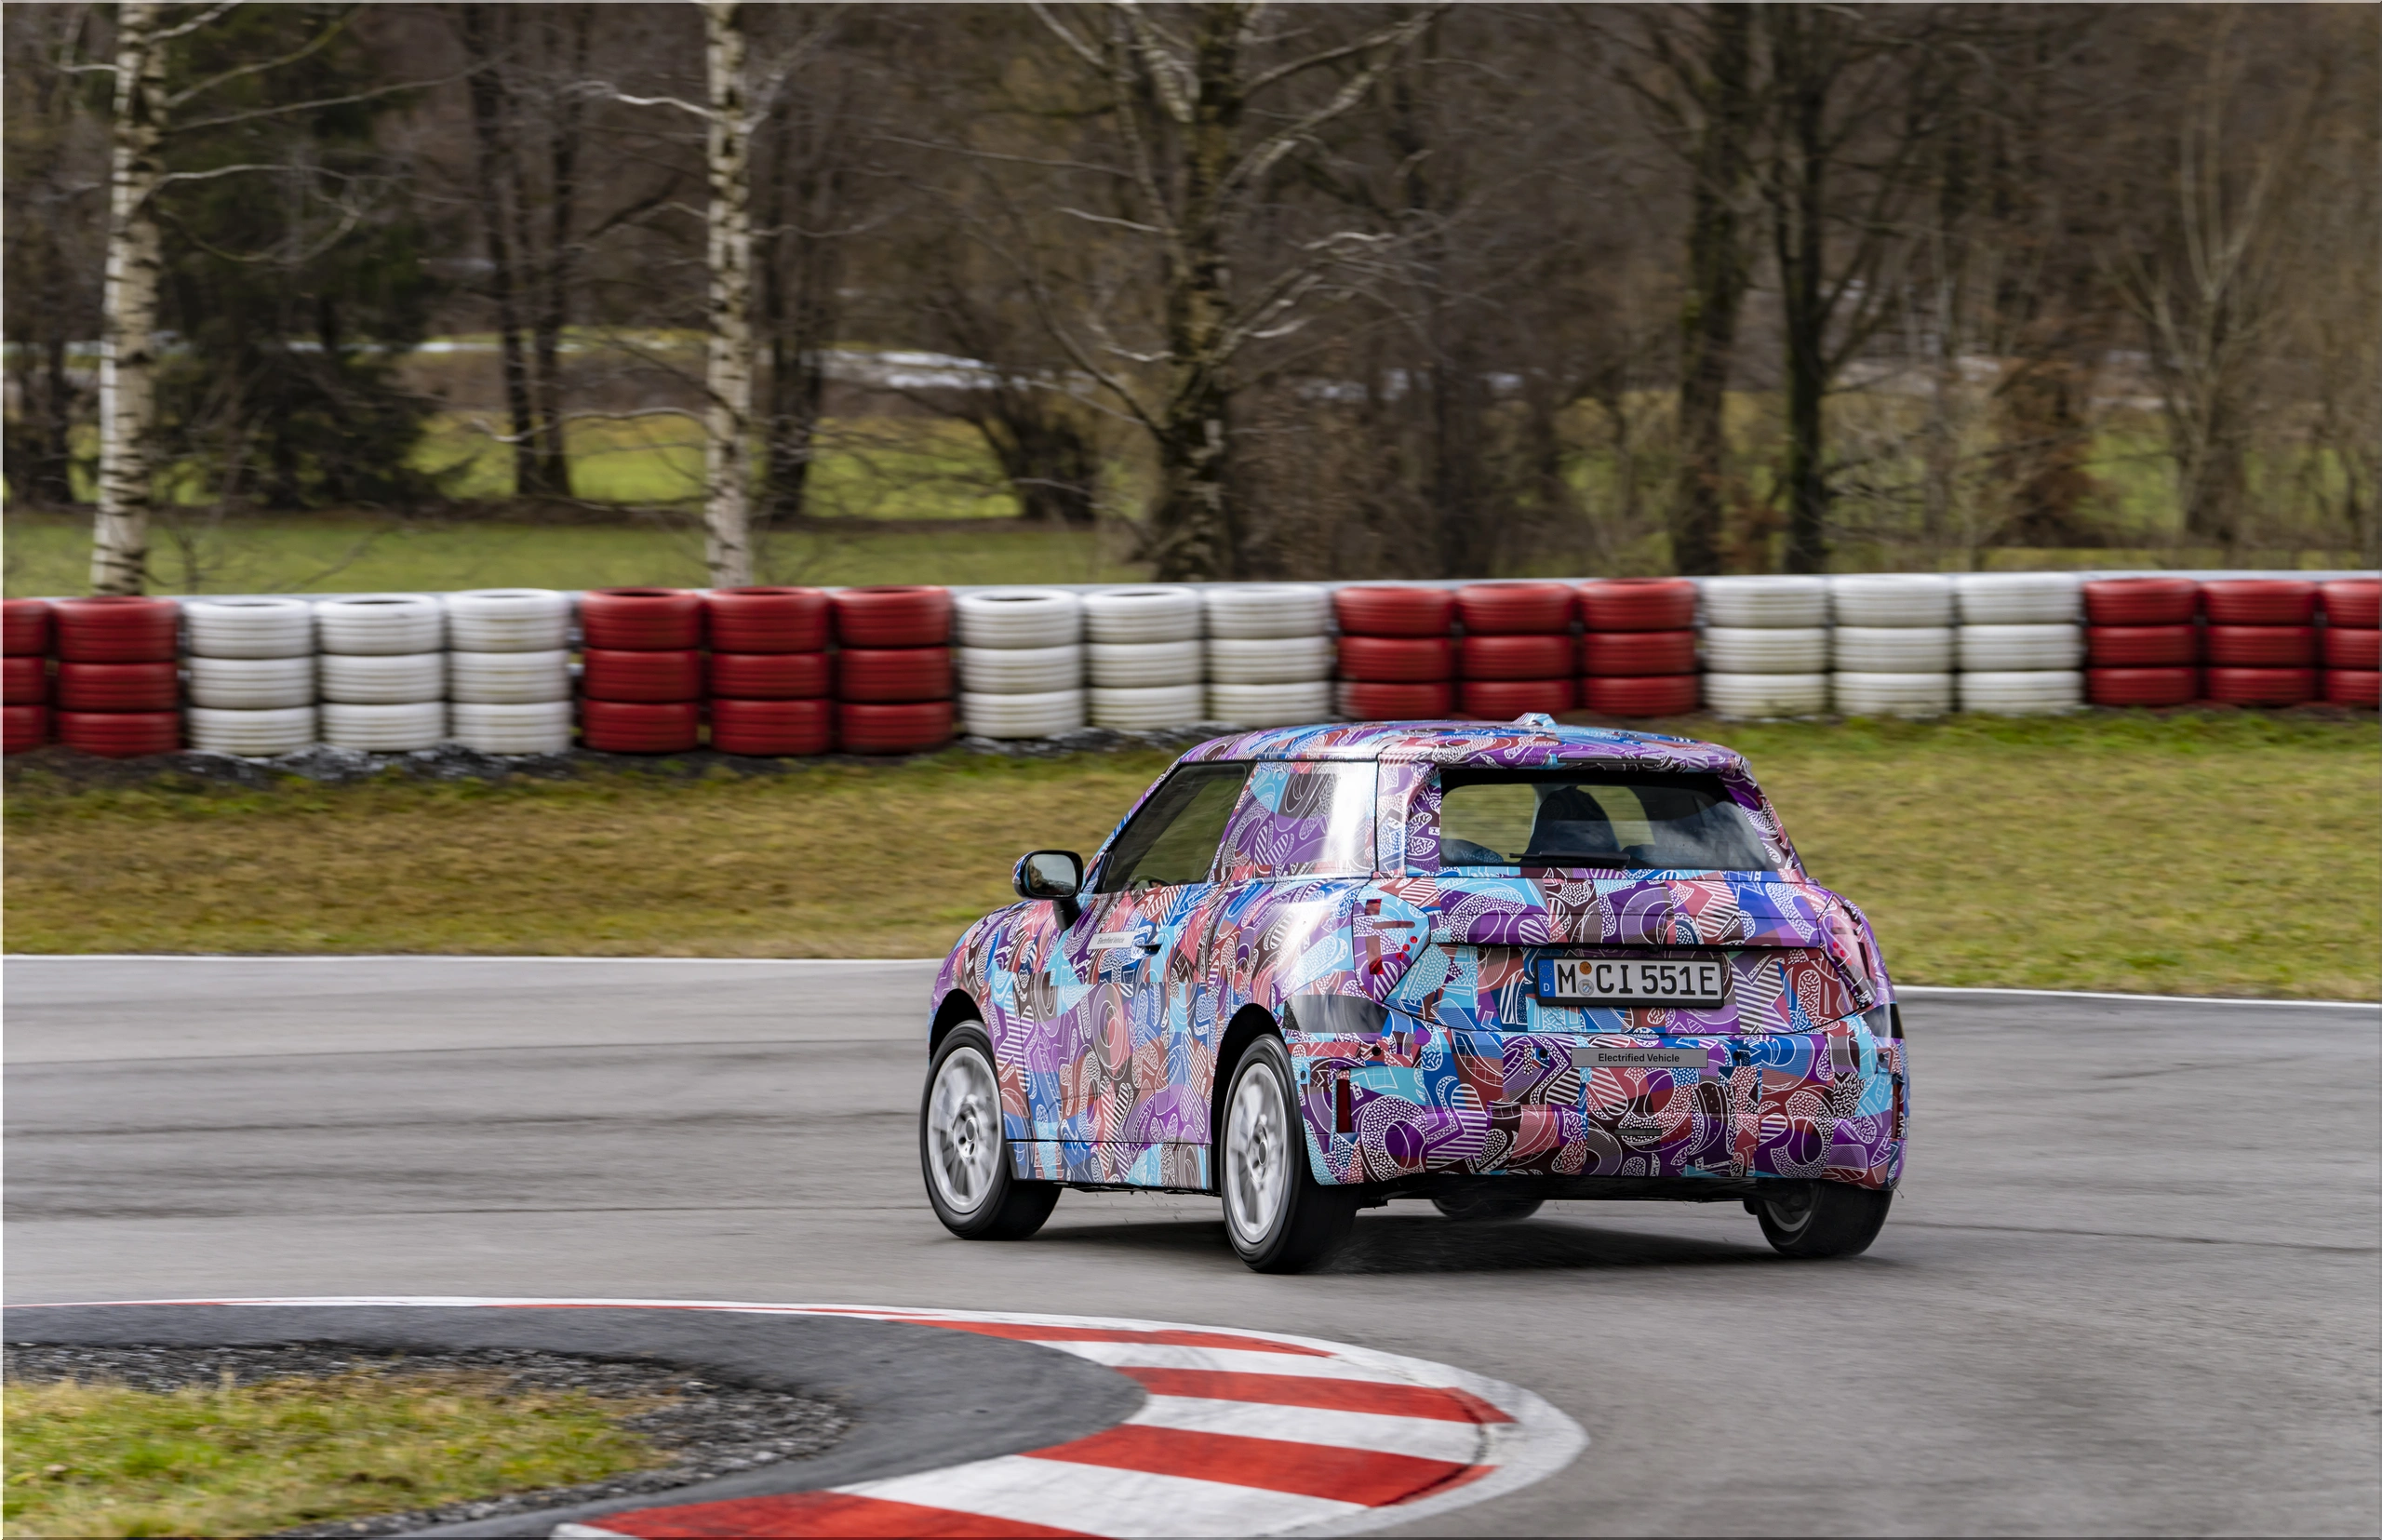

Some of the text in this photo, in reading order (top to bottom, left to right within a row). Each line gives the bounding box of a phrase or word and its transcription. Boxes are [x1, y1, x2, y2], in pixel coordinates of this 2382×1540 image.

[1557, 963, 1719, 996] M CI 551E
[1543, 983, 1550, 992] D
[1598, 1052, 1679, 1063] Electrified Vehicle
